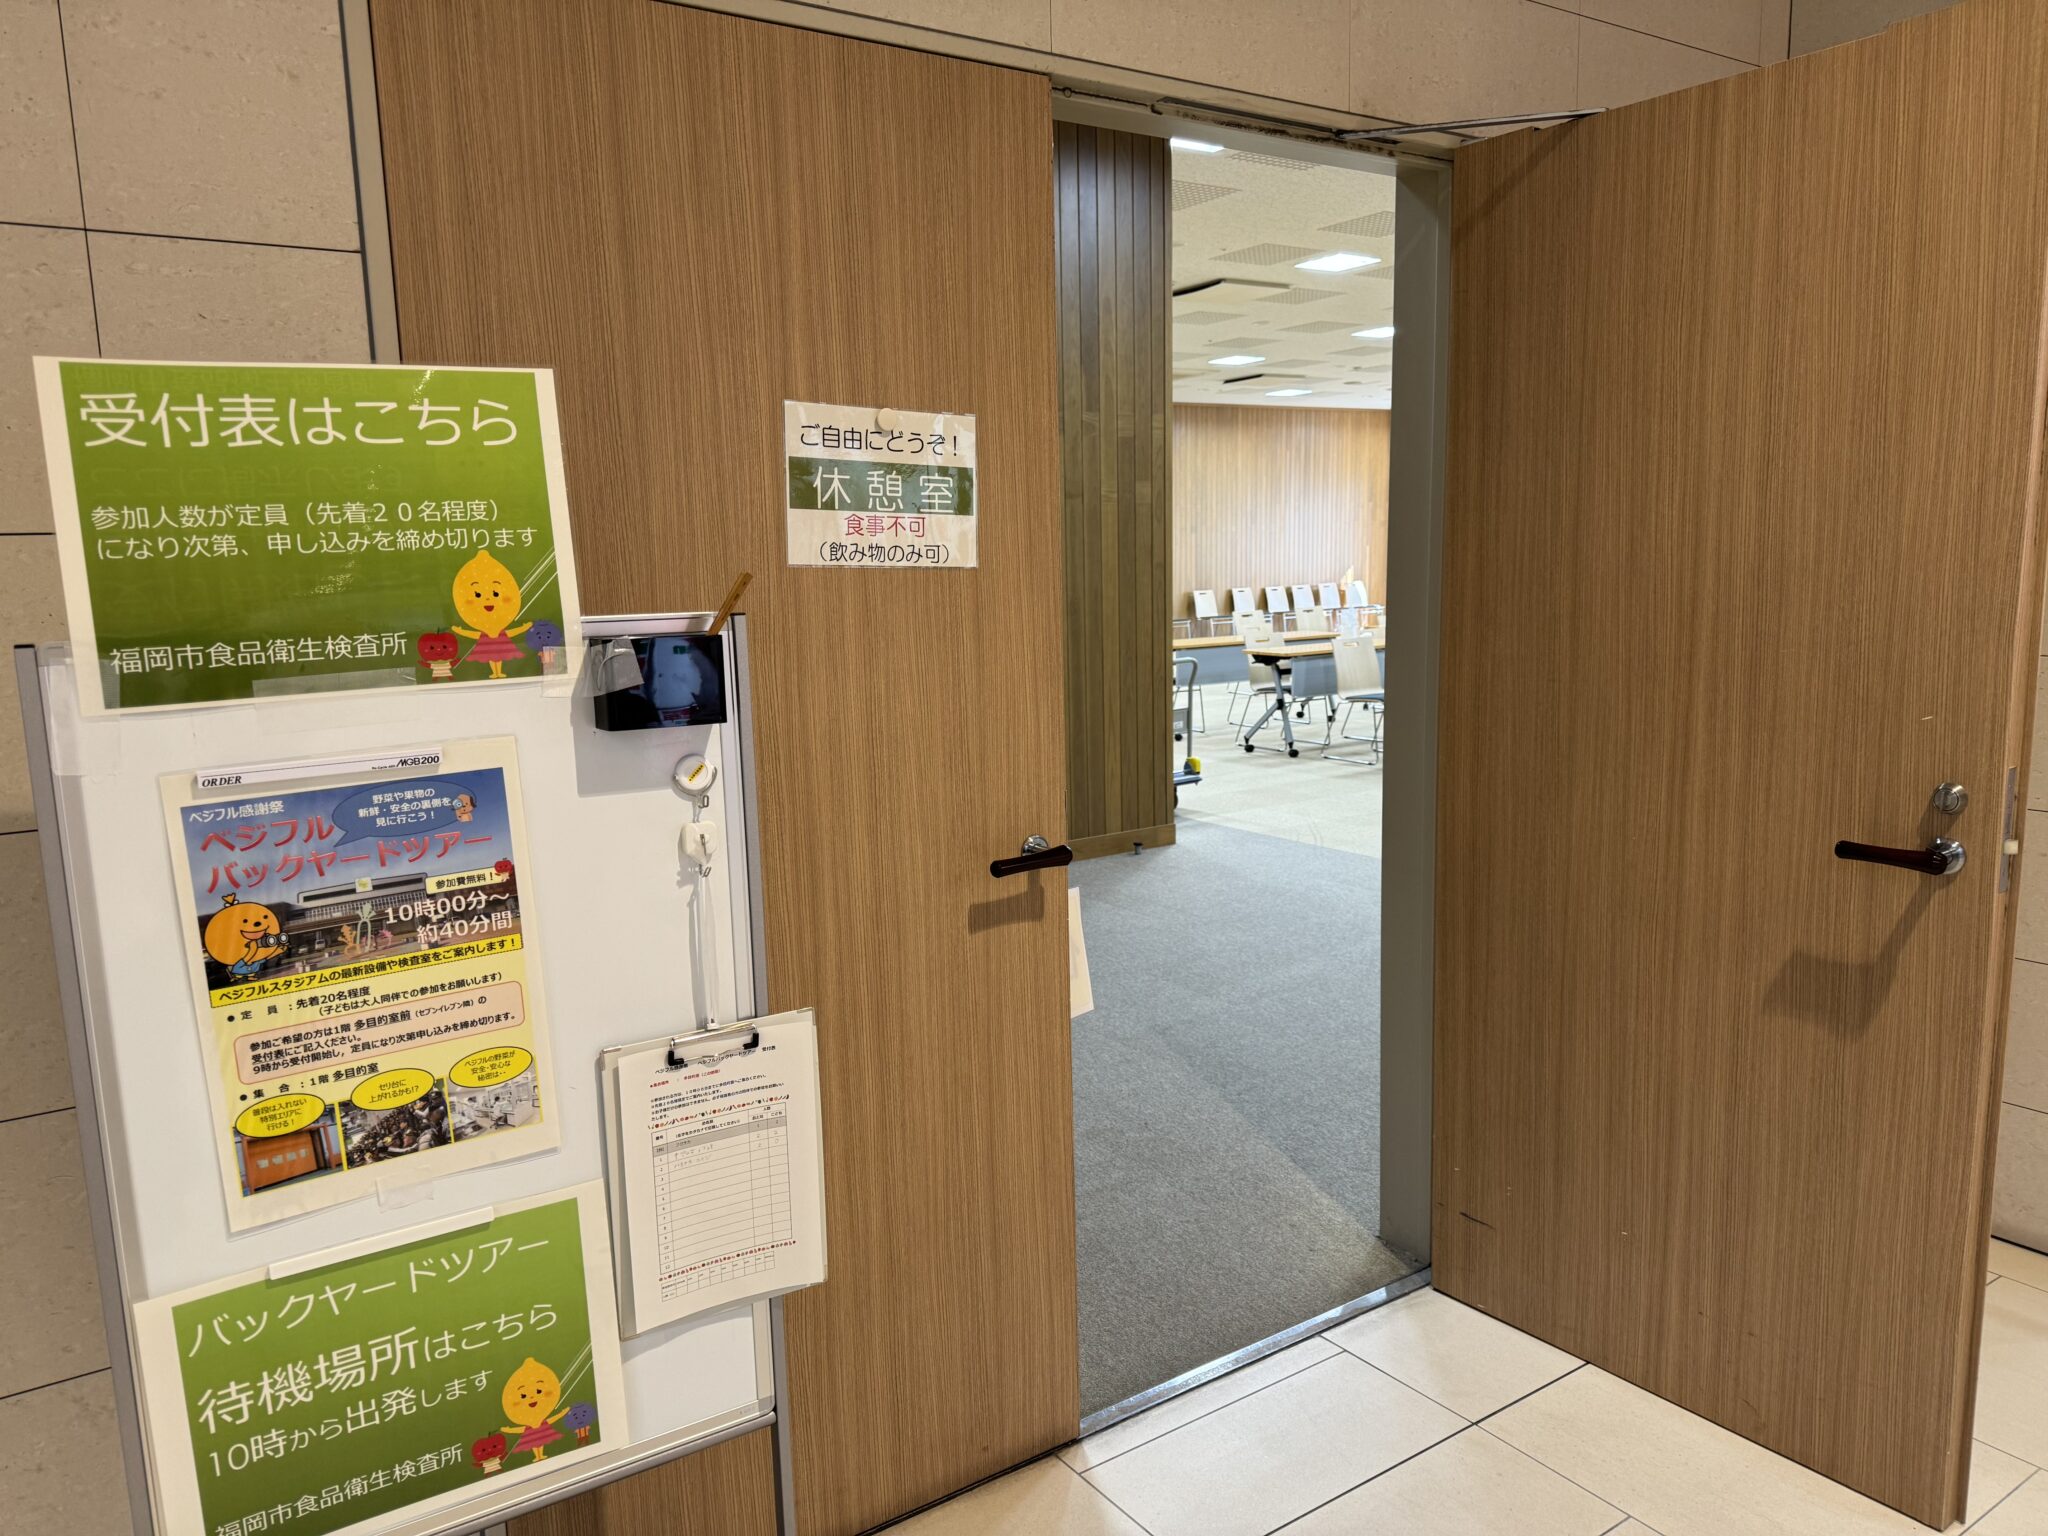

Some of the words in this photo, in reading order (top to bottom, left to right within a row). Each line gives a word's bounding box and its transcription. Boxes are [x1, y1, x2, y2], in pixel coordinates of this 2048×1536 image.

[79, 392, 518, 447] 受付表はこちら
[800, 424, 958, 456] ご自由にどうぞ！
[813, 465, 954, 513] 休憩室
[90, 499, 501, 530] 参加人数が定員（先着２０名程度）
[844, 513, 926, 537] 食事不可
[97, 526, 538, 560] になり次第、申し込みを締め切ります
[819, 541, 950, 564] （飲み物のみ可）
[110, 631, 407, 675] 福岡市食品衛生検査所
[202, 776, 242, 788] ORDER
[372, 787, 435, 805] 野菜や果物の
[189, 800, 284, 823] ベジフル感謝祭
[358, 797, 452, 818] 新鮮・安全の裏側を
[376, 811, 435, 828] 見に行こう！
[200, 814, 335, 853] ベジフル
[207, 829, 493, 893] バックヤードツアー
[435, 872, 494, 890] 参加費無料！
[417, 911, 513, 944] 約40分間
[219, 939, 518, 1001] ベジフルスタジアムの最新設備や検査室をご案内します！
[251, 1036, 362, 1065] 受付表にご記入ください。
[465, 1050, 516, 1067] ベジフルの野菜が
[252, 1098, 308, 1117] 普段は入れない
[260, 1108, 303, 1124] 特別エリアに
[188, 1237, 550, 1358] バックヤードツアー
[197, 1303, 558, 1434] 待機場所はこちら
[208, 1369, 494, 1477] 10時から出発します
[214, 1443, 464, 1536] 福岡市食品衛生検査所
